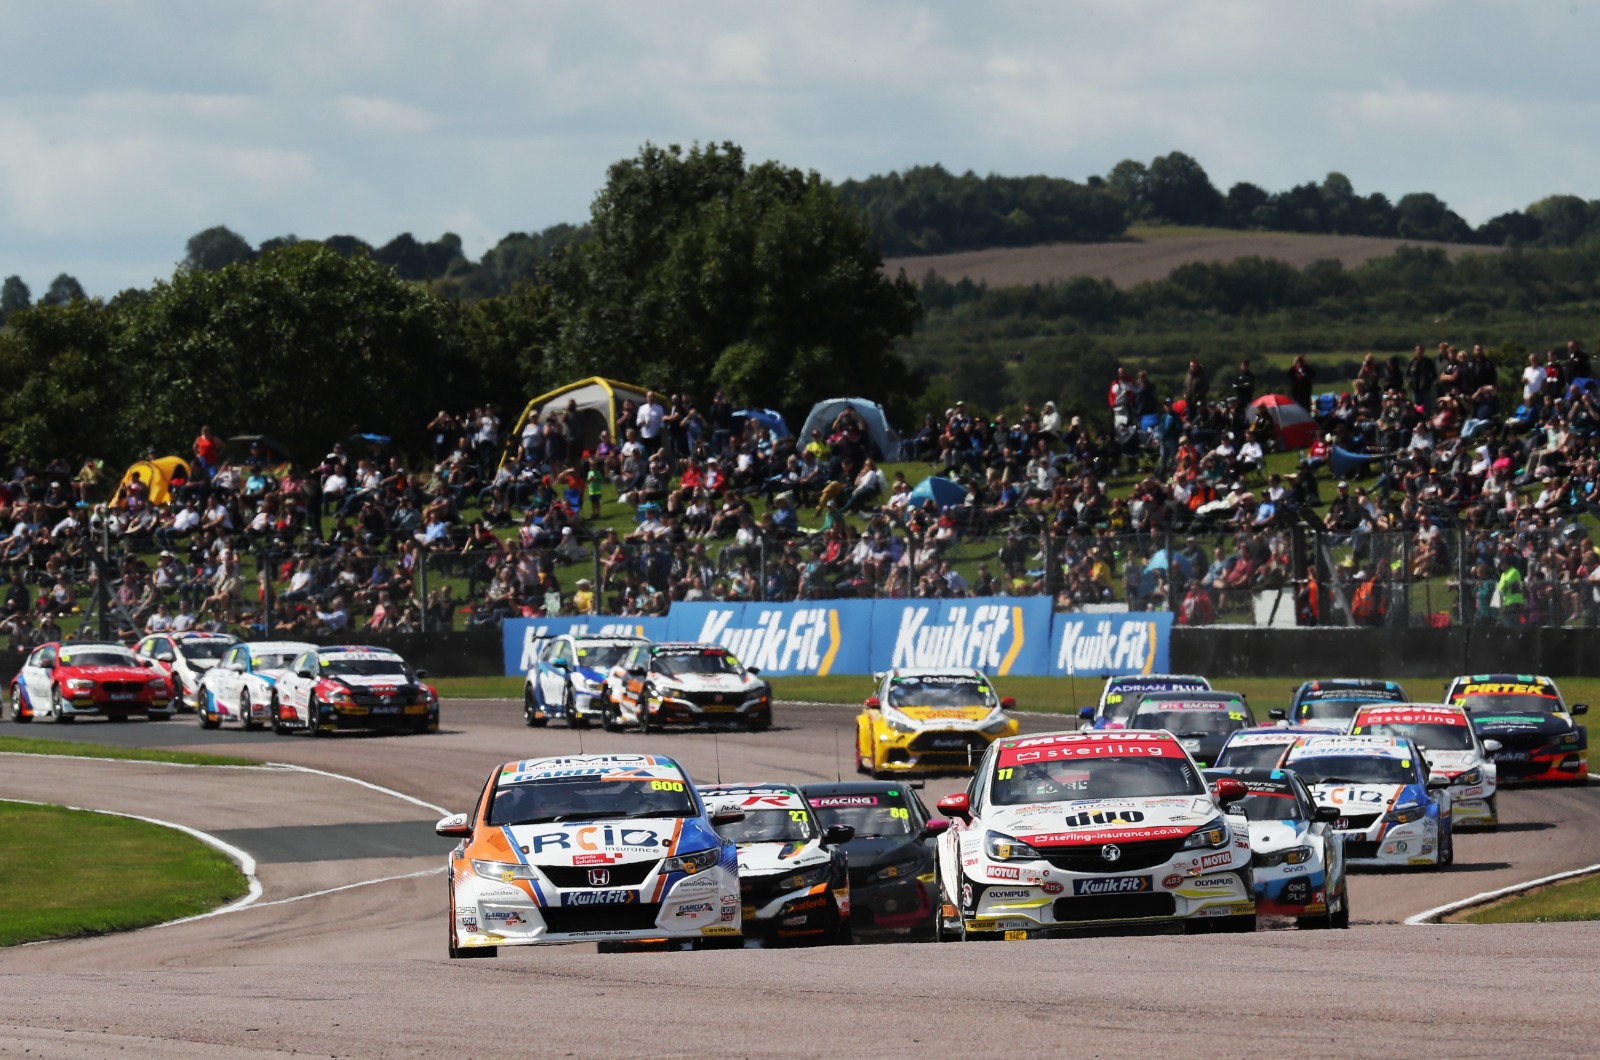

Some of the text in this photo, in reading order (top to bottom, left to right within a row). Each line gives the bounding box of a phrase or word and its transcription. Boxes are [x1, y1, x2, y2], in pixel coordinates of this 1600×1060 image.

[1464, 684, 1544, 695] PIRTEK
[1385, 714, 1455, 724] sterling
[1018, 734, 1158, 748] MOTUL
[1047, 745, 1163, 757] sterling
[998, 768, 1013, 780] 11
[651, 781, 683, 792] 600
[820, 797, 871, 805] RACING
[789, 811, 808, 822] 27
[890, 807, 909, 819] 66
[1066, 811, 1144, 827] duo
[1049, 827, 1184, 842] sterling-insurance.co.uk
[1235, 841, 1249, 849] 3M
[964, 858, 978, 866] 3M
[1204, 853, 1231, 867] MOTUL
[987, 867, 1019, 879] MOTUL
[1195, 878, 1233, 887] OLYMPUS
[989, 890, 1030, 898] OLYMPUS
